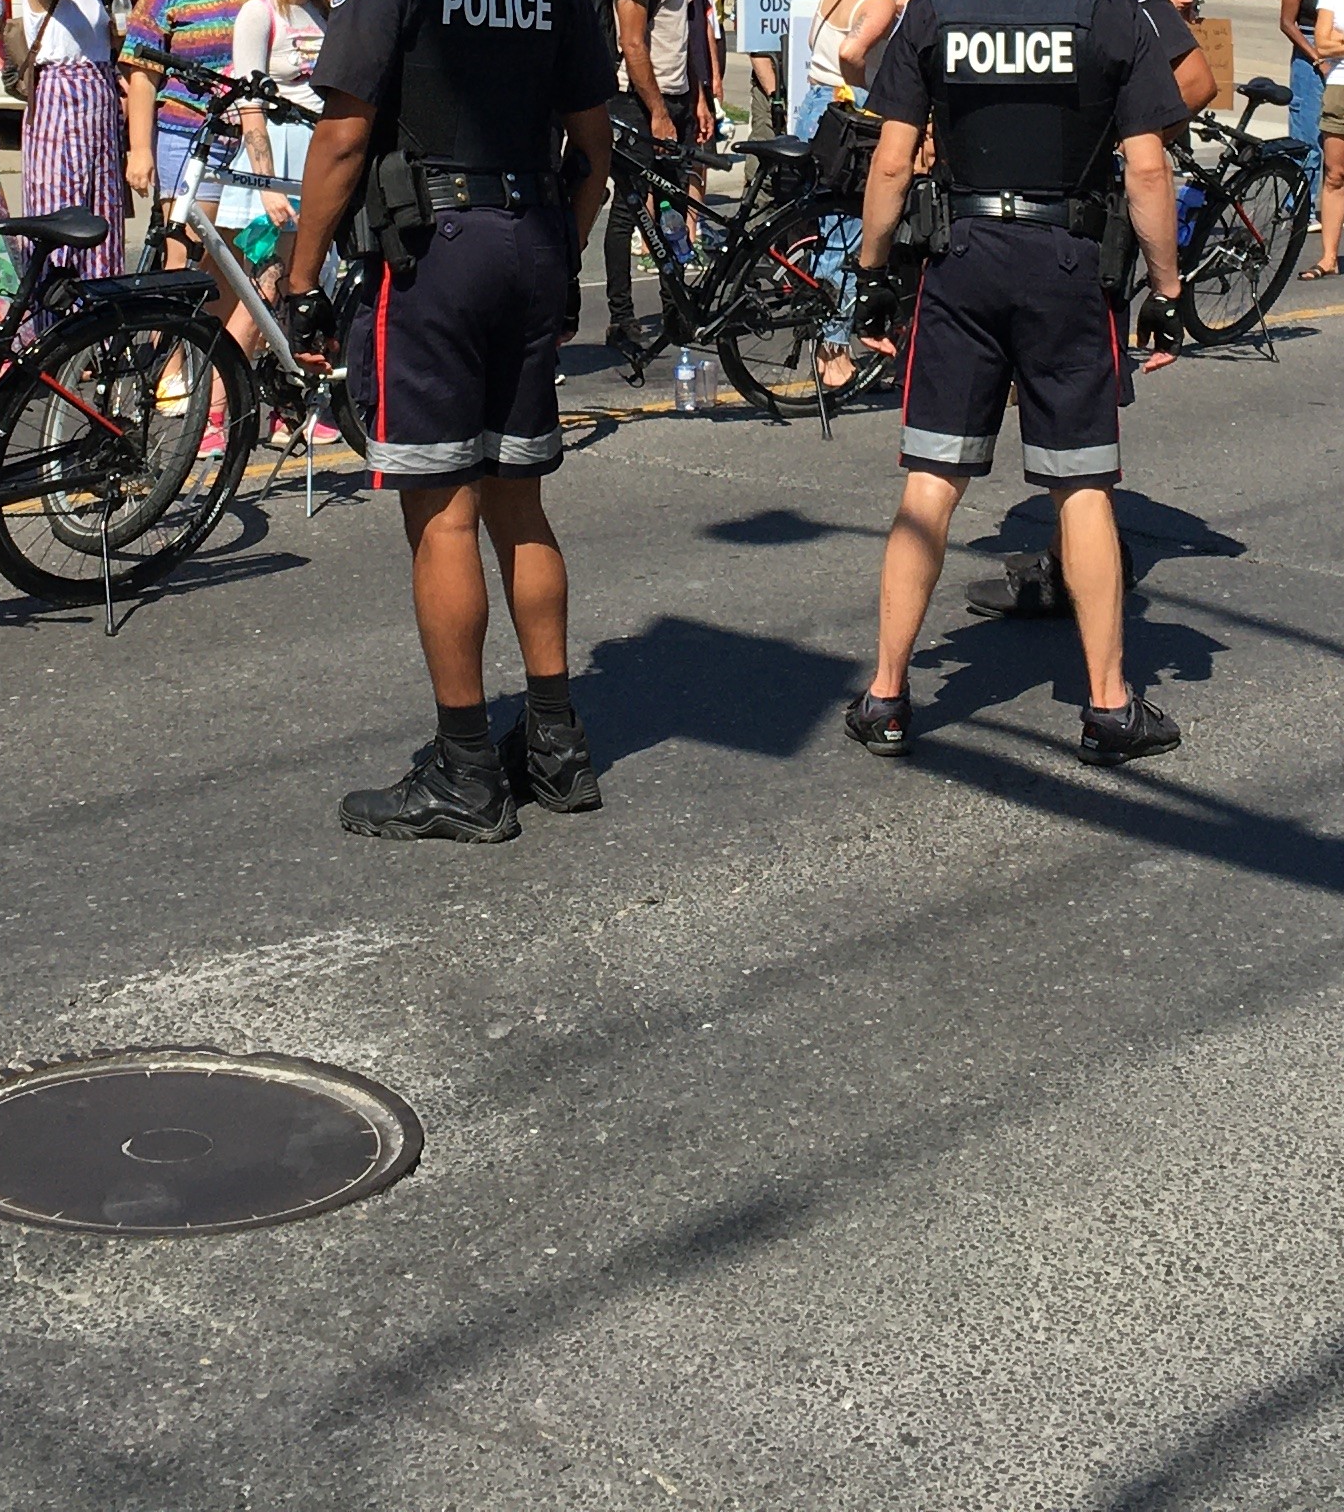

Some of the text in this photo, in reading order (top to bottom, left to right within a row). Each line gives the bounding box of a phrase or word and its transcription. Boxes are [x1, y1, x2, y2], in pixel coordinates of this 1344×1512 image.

[947, 31, 1073, 74] POLICE
[232, 174, 271, 188] POLICE
[637, 208, 666, 259] TORONTO
